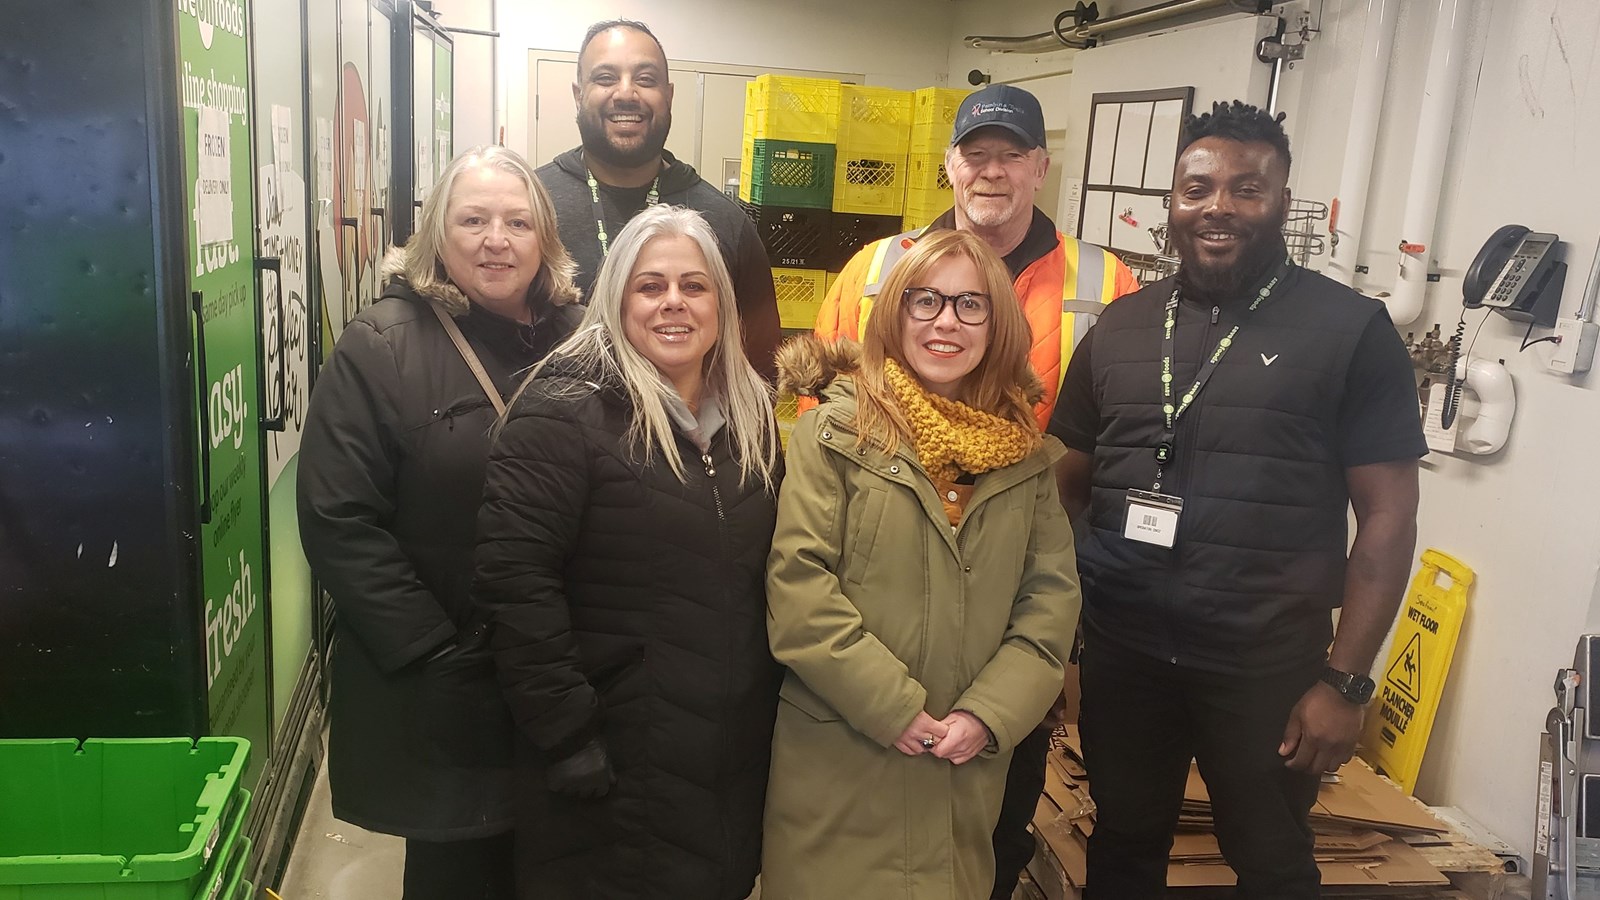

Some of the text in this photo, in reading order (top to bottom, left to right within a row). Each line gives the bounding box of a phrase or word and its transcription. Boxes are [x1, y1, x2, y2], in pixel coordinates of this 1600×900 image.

[214, 0, 243, 38] foods
[182, 61, 247, 126] line shopping
[204, 133, 226, 158] FROZEN
[284, 235, 303, 281] MONEY
[218, 289, 229, 318] day
[239, 284, 247, 307] up
[1210, 345, 1226, 364] foods
[208, 363, 248, 450] asy.
[204, 548, 257, 692] fresh.
[1407, 605, 1439, 635] WET FLOOR
[1379, 702, 1409, 735] MOUILLÉ
[1382, 685, 1415, 721] PLANCHER
